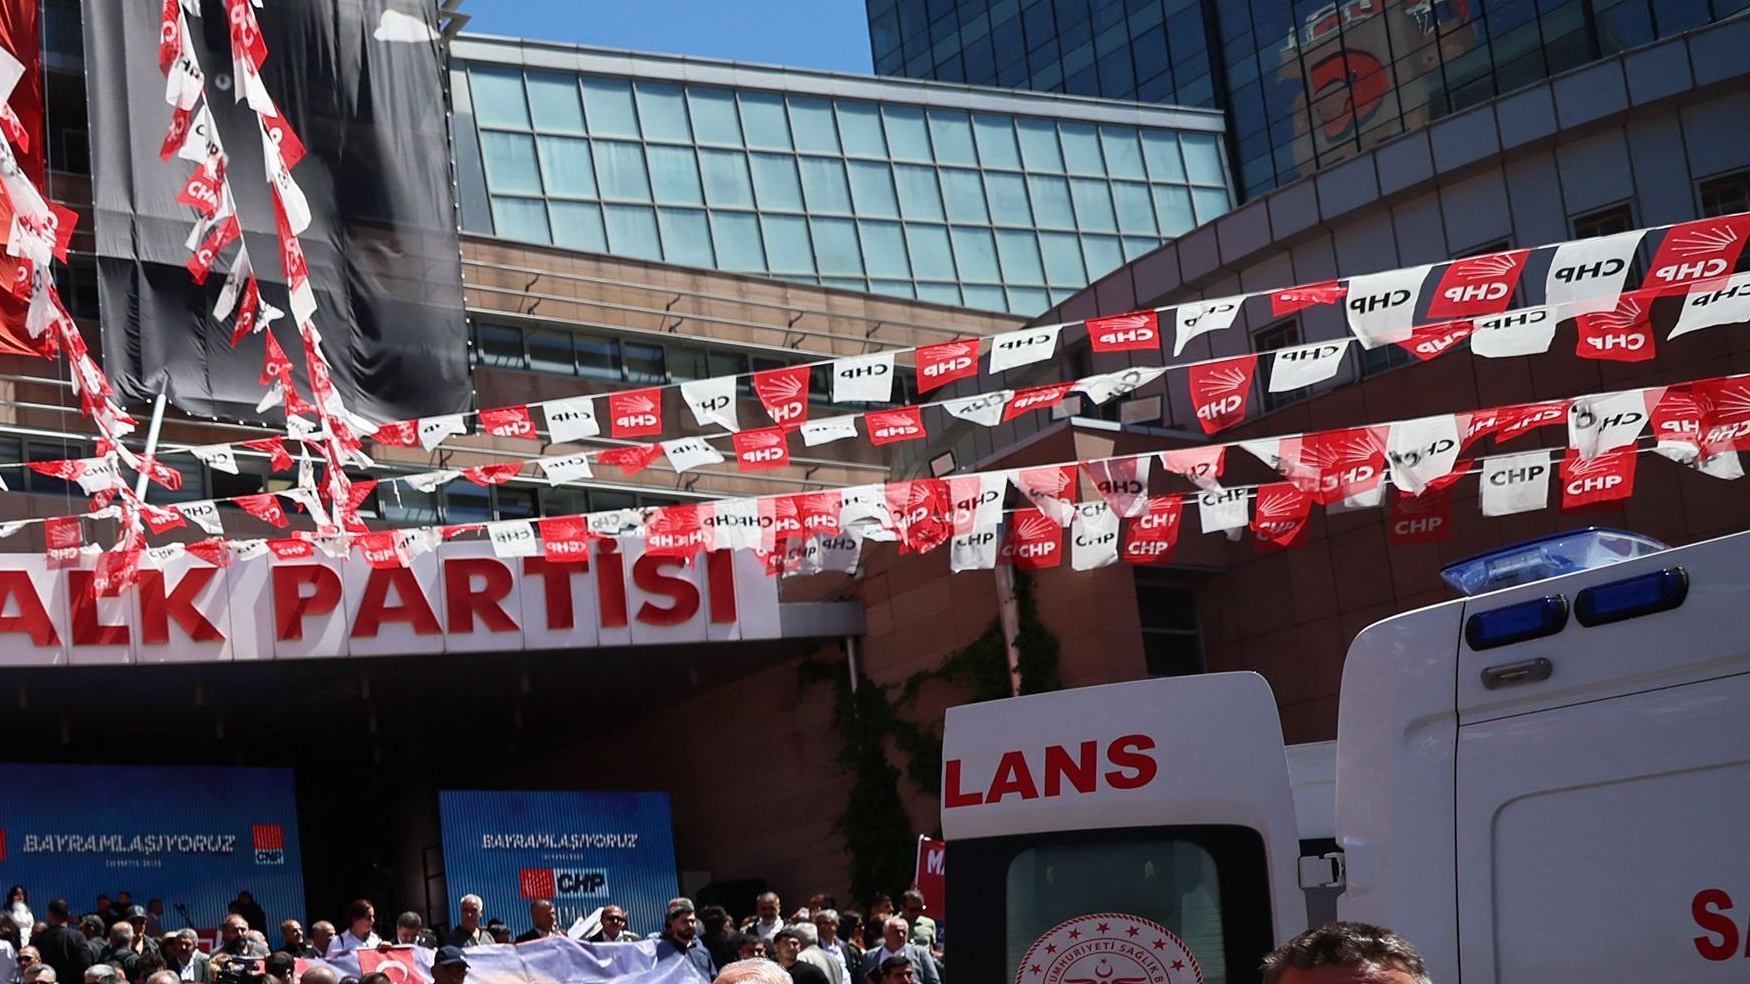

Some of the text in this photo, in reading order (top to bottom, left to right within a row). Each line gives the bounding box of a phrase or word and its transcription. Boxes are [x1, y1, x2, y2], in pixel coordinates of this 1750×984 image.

[1490, 465, 1545, 486] CHP
[1566, 475, 1623, 495] CHP
[1394, 517, 1443, 535] CHP
[1018, 541, 1056, 557] CHP
[1127, 541, 1169, 556] CHP
[944, 734, 1158, 808] LANS
[557, 873, 605, 893] CHP
[1691, 888, 1750, 962] S
[1119, 943, 1161, 975] SAĞLIK
